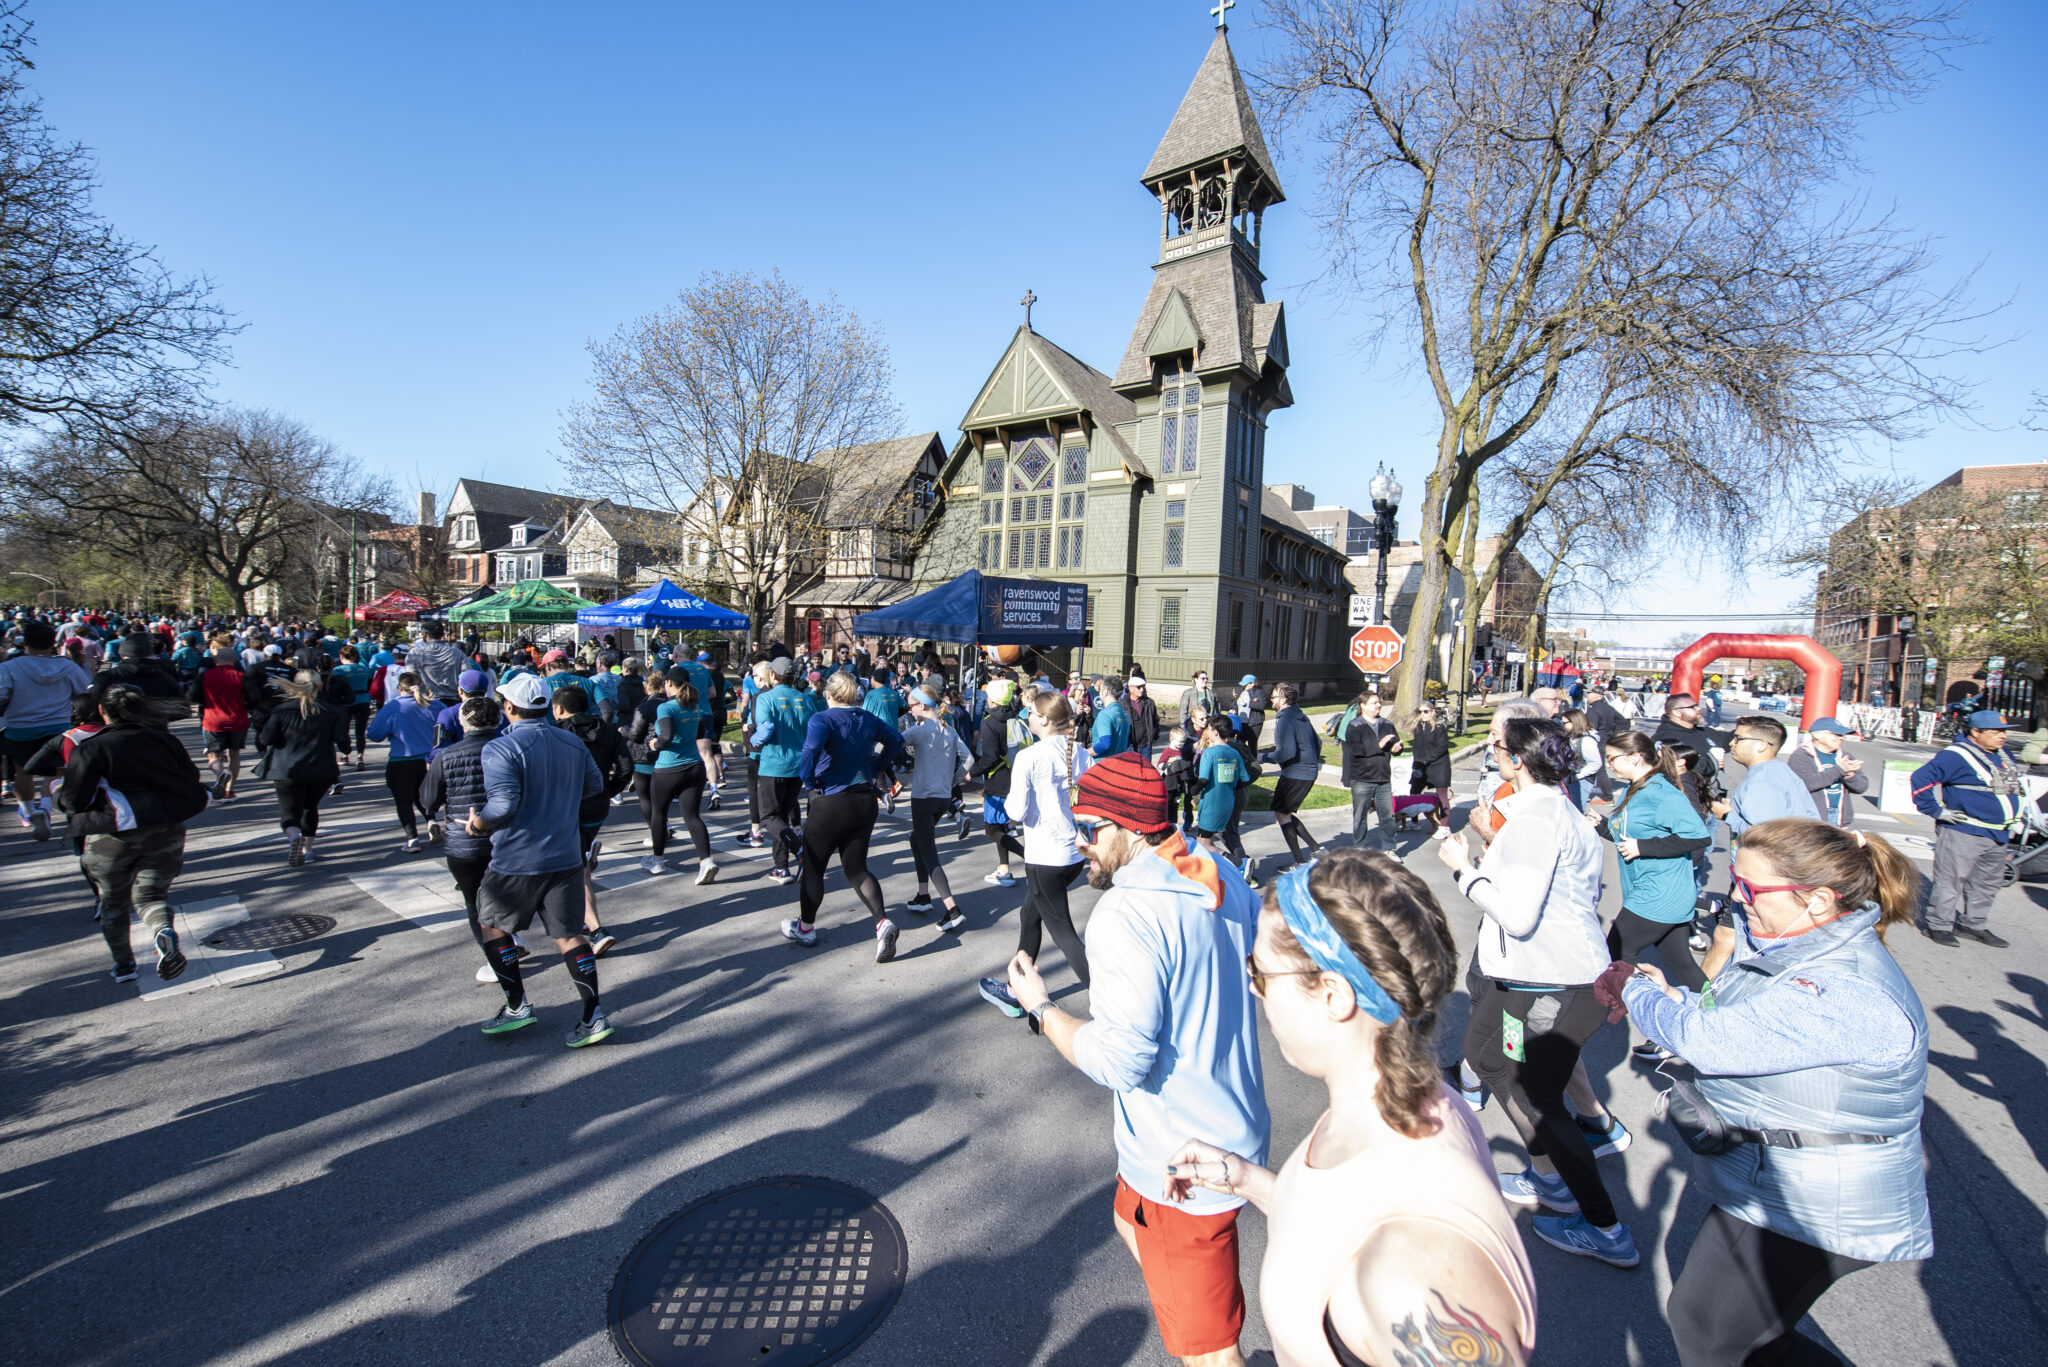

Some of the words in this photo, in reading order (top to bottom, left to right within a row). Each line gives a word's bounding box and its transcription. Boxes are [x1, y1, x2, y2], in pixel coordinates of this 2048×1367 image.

[1004, 587, 1060, 600] ravenswood
[1003, 600, 1060, 614] community
[1003, 612, 1041, 622] services
[1354, 640, 1399, 659] STOP
